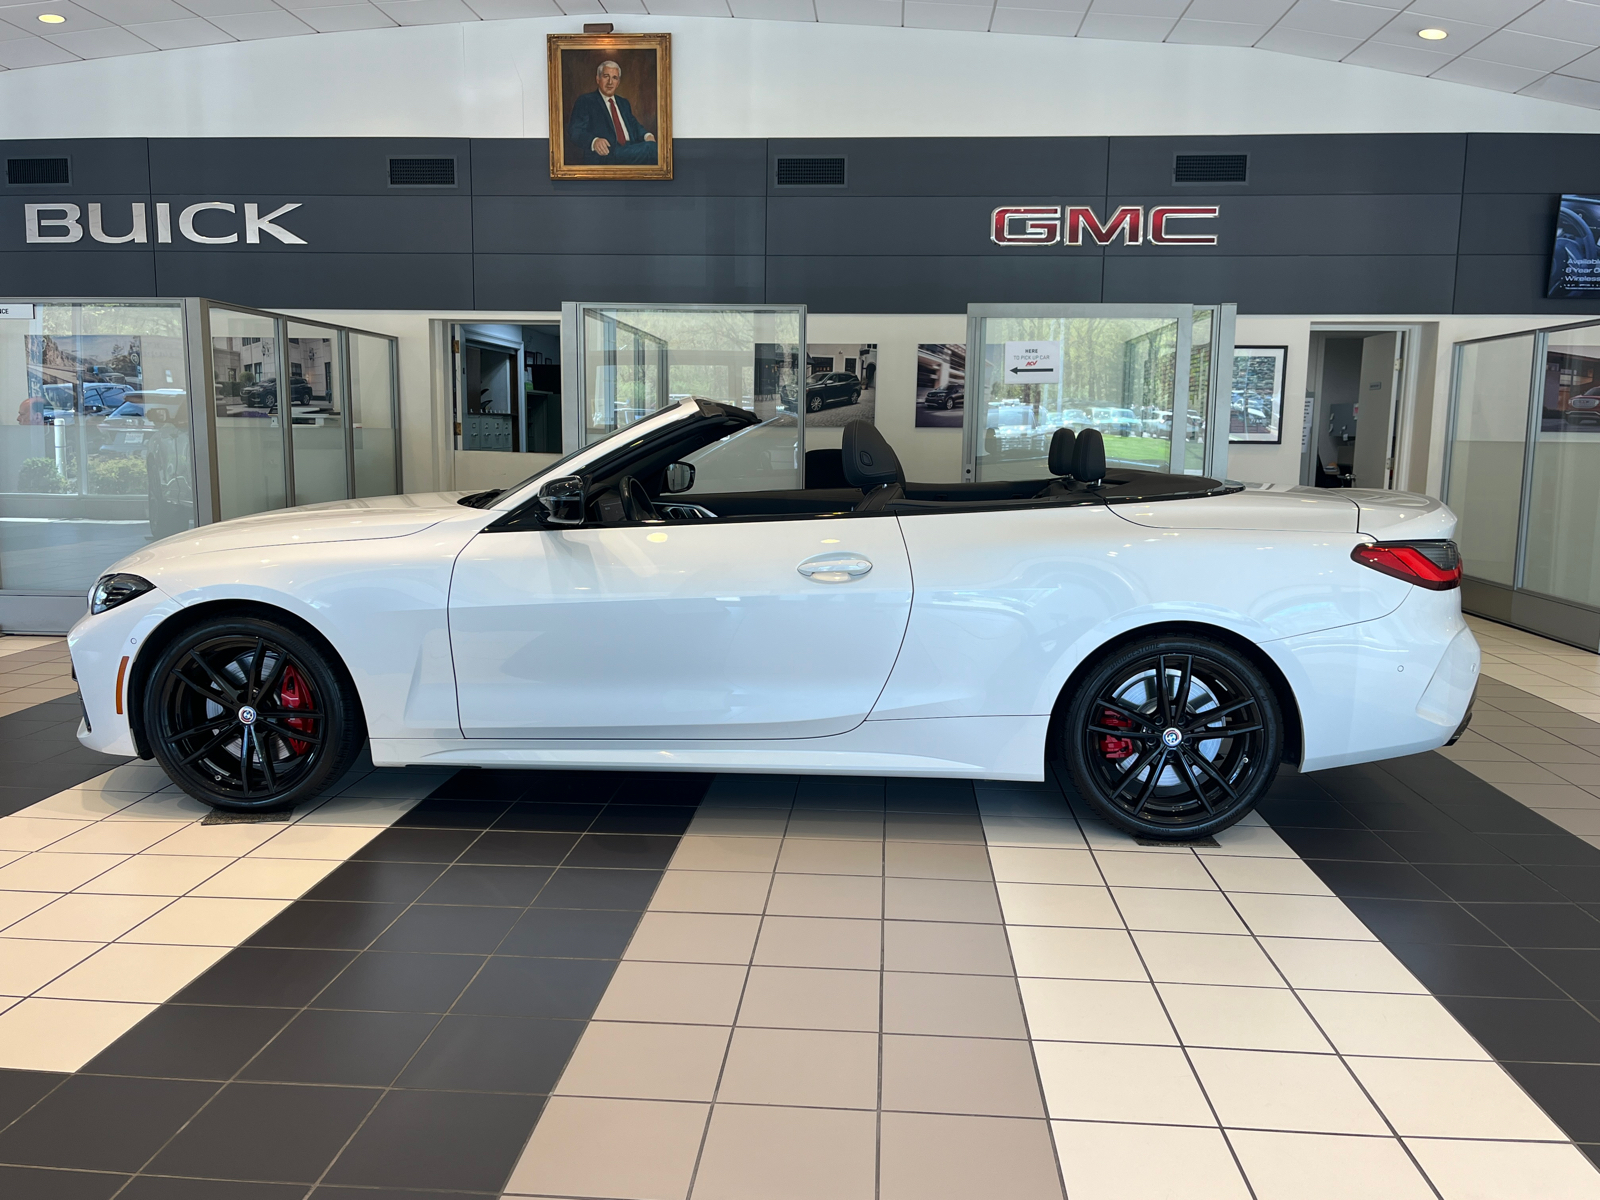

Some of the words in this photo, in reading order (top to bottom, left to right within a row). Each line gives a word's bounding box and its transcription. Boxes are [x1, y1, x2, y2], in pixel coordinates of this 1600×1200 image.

[24, 201, 308, 245] BUICK
[990, 204, 1221, 247] GMC
[1109, 642, 1160, 671] BRIDGESTONE
